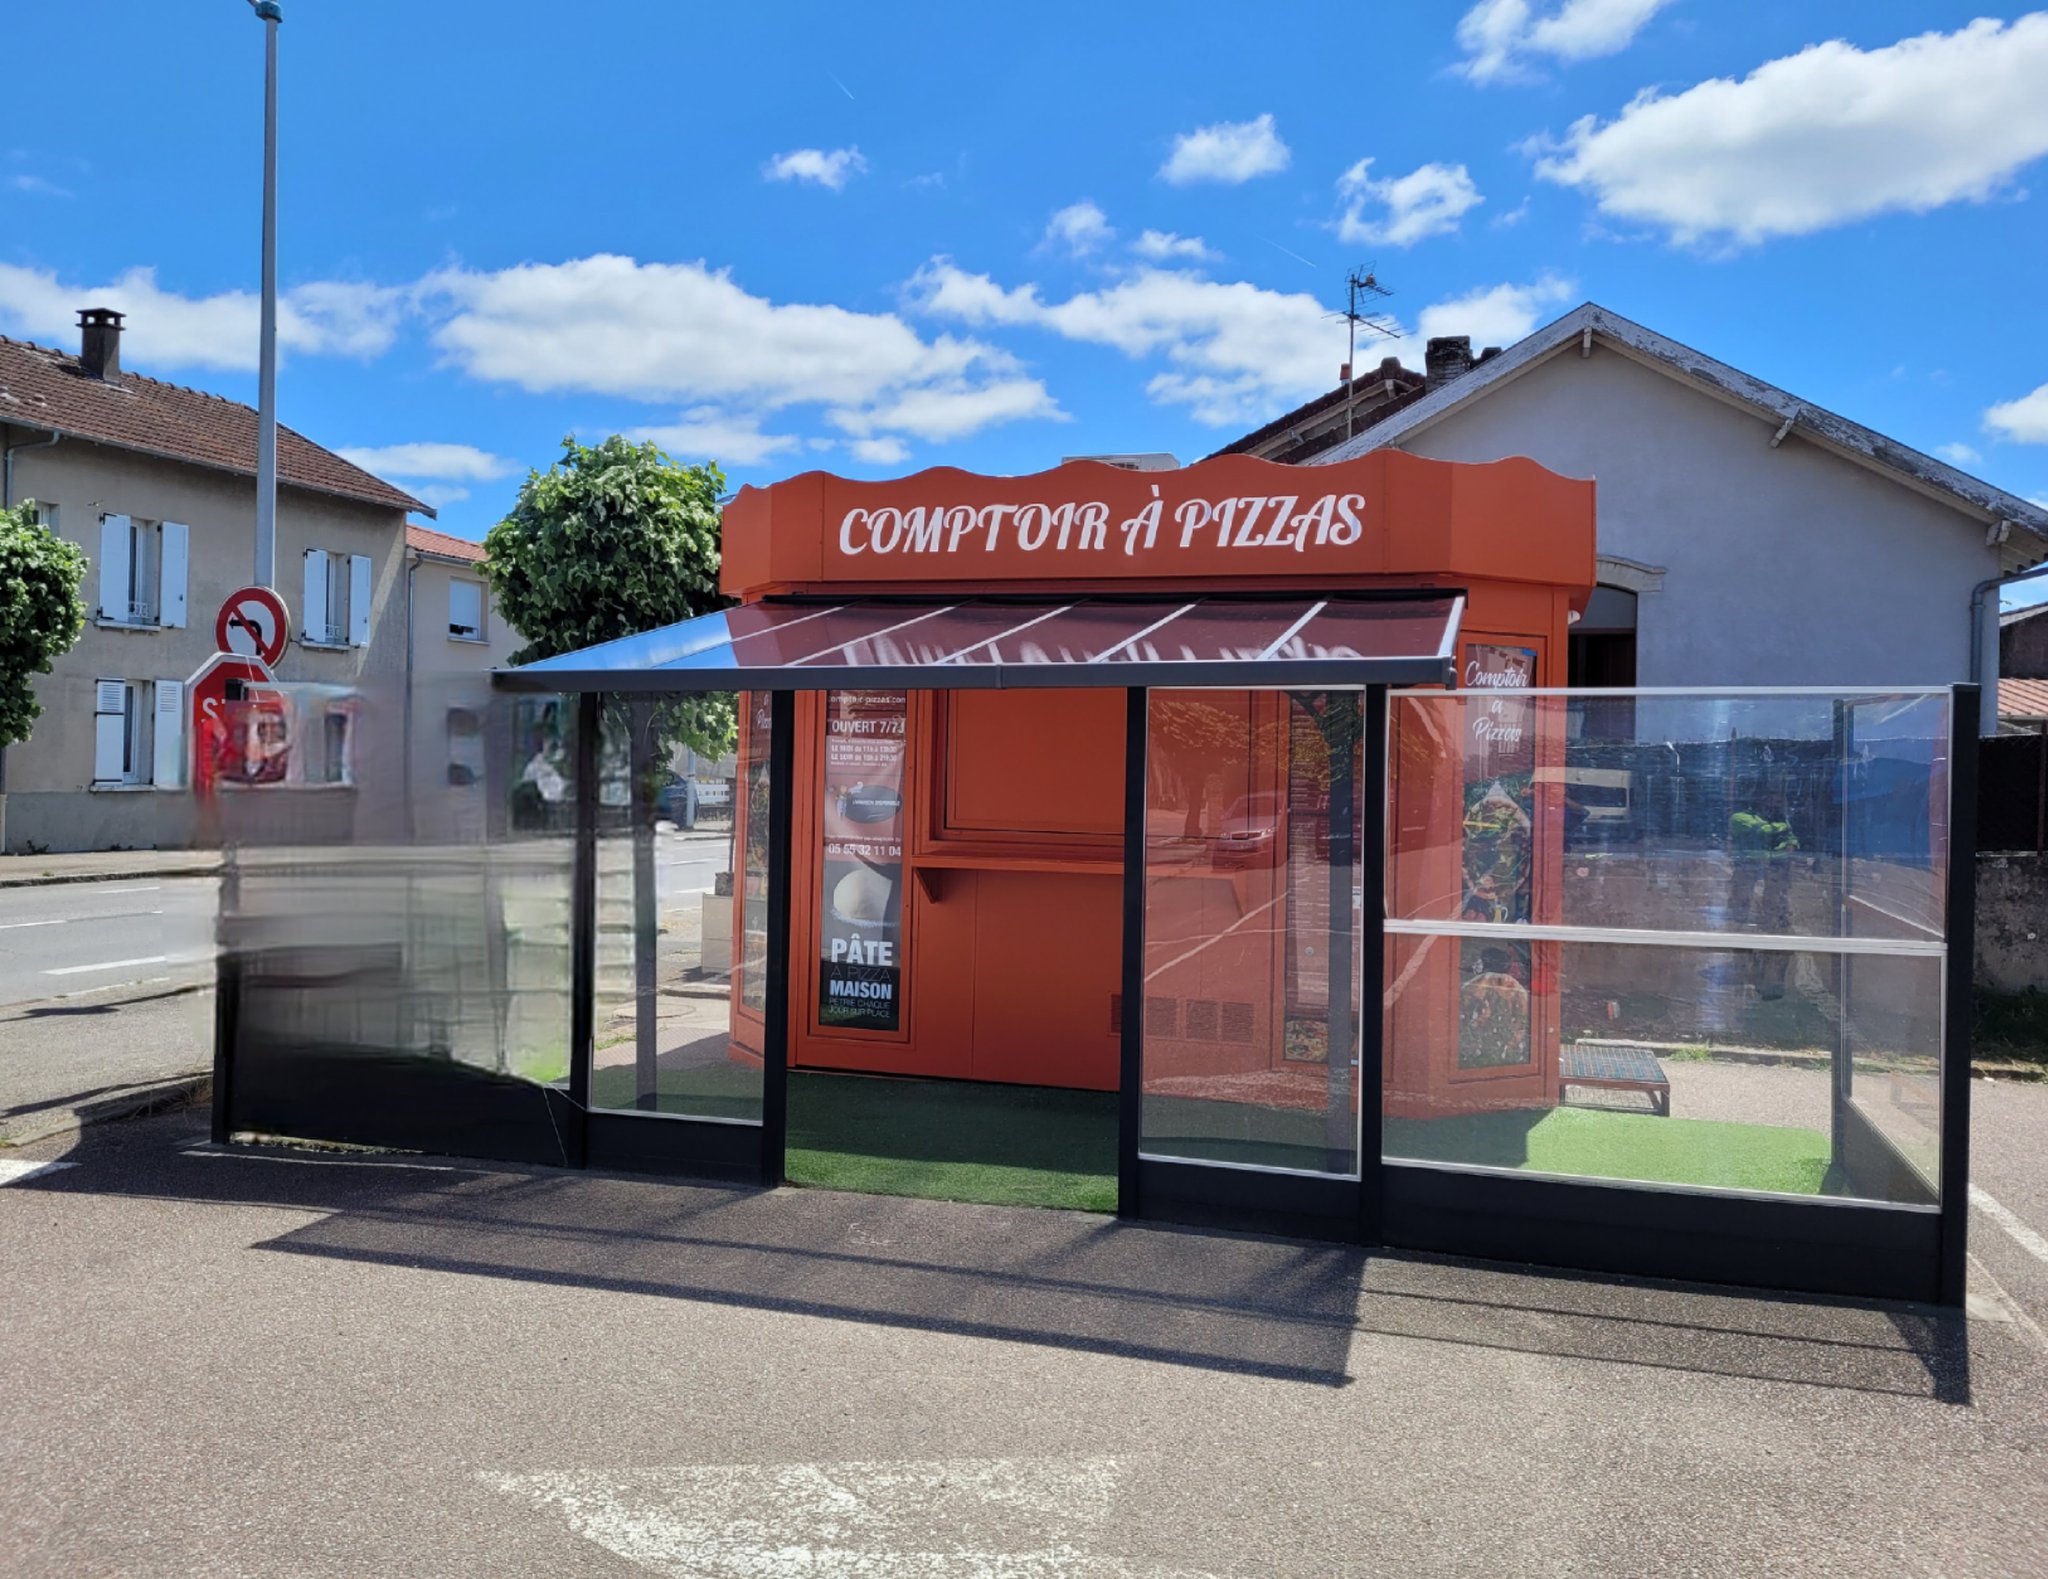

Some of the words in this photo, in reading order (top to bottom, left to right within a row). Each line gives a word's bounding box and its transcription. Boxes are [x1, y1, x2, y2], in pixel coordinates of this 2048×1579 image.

[839, 501, 1110, 556] COMPTOIR
[1120, 484, 1164, 556] À
[1174, 493, 1366, 553] PIZZAS
[1465, 660, 1528, 689] Comptoir
[831, 720, 877, 733] OUVERT
[1472, 716, 1522, 742] Pizzas
[828, 843, 840, 854] 05
[873, 845, 885, 856] 11
[888, 845, 901, 857] 04
[832, 933, 892, 966] PÂTE
[847, 966, 891, 982] PIZZA
[829, 979, 892, 1000] MAISON
